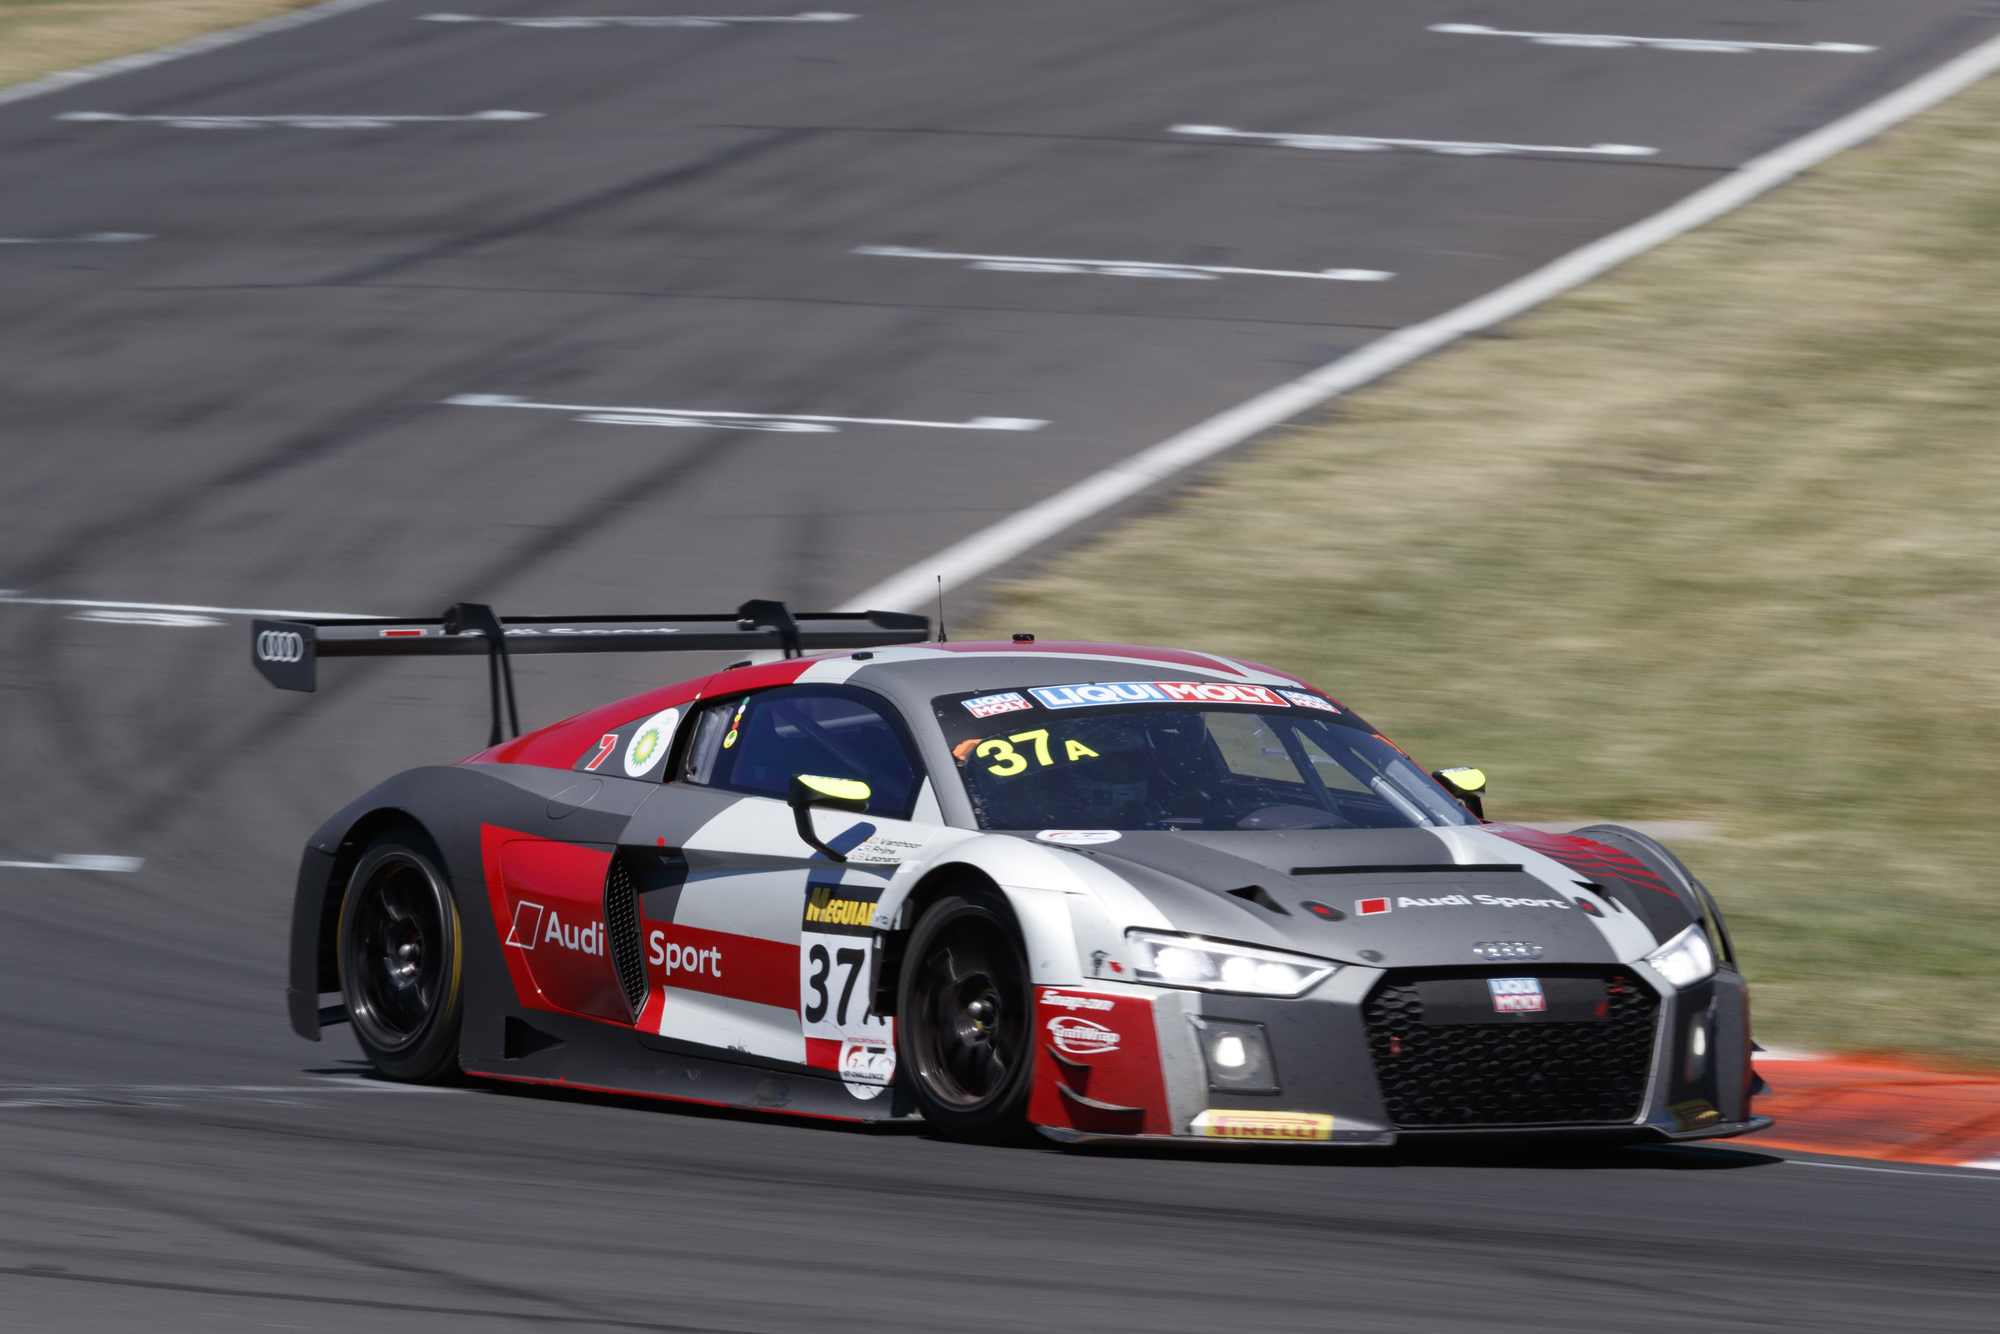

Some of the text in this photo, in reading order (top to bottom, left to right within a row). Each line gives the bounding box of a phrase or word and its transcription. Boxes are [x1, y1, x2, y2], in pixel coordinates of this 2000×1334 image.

[967, 692, 1020, 708] LIQUI
[1038, 684, 1274, 705] LIQUI MOLY
[976, 700, 1027, 717] MOLY
[976, 729, 1100, 776] 37 A
[1397, 894, 1571, 909] Audi Sport
[544, 911, 722, 978] Audi Sport
[1490, 980, 1540, 994] LIQUI
[1494, 994, 1543, 1010] MOLY
[1217, 1115, 1319, 1139] PIRELLI
